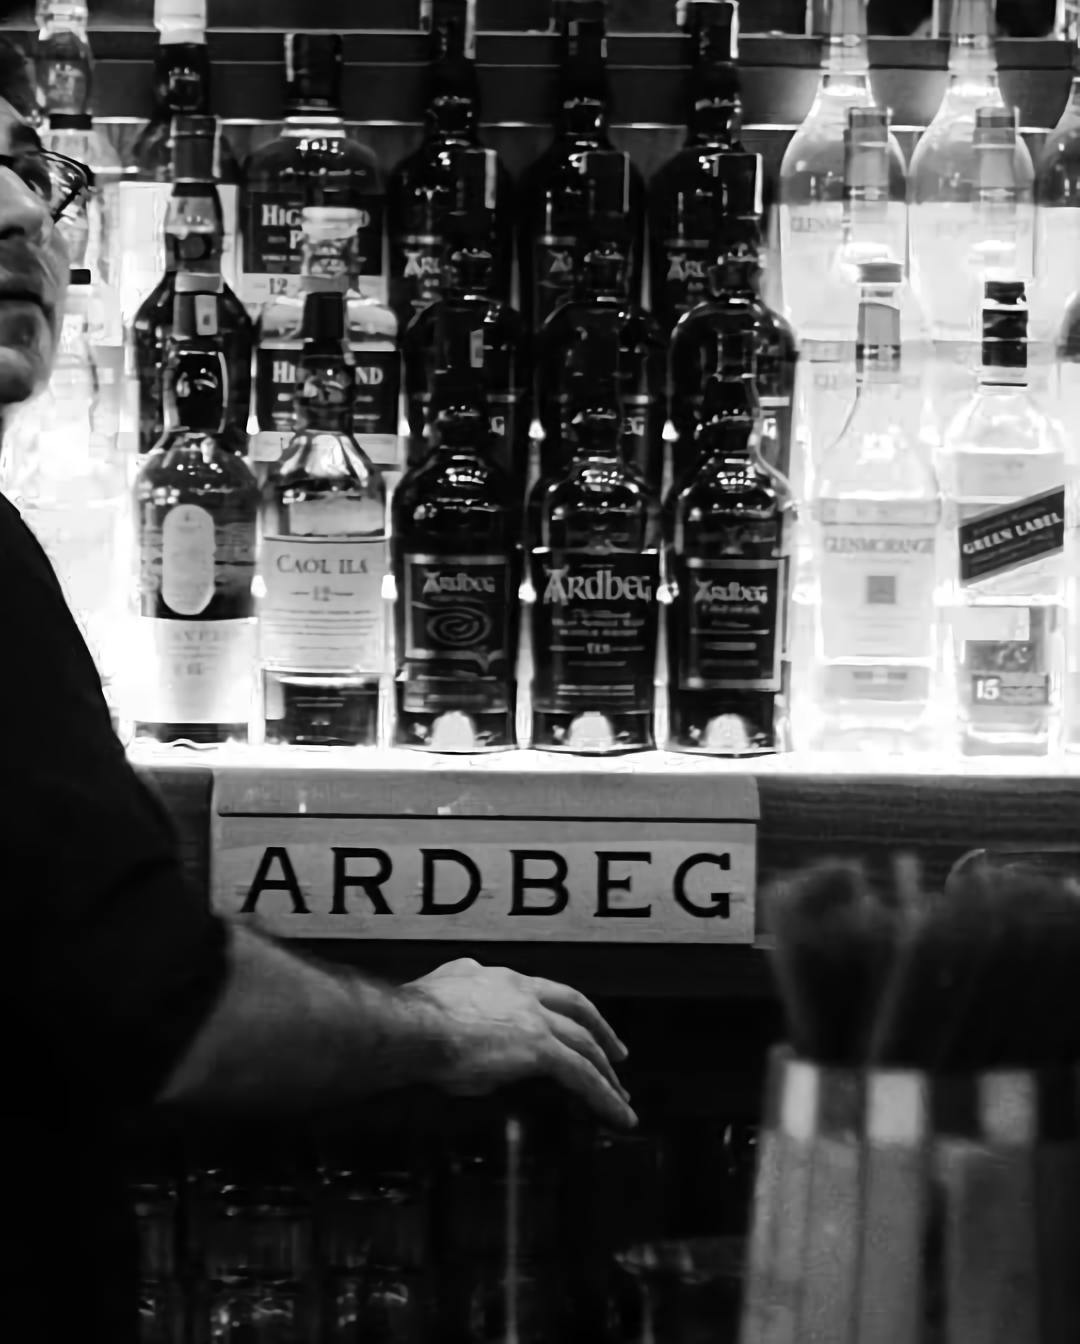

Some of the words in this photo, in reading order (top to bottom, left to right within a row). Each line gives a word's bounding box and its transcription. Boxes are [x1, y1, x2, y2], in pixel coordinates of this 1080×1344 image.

[962, 528, 1013, 554] GREEN
[1015, 512, 1063, 536] LABEL
[239, 846, 732, 920] ARDBEG
